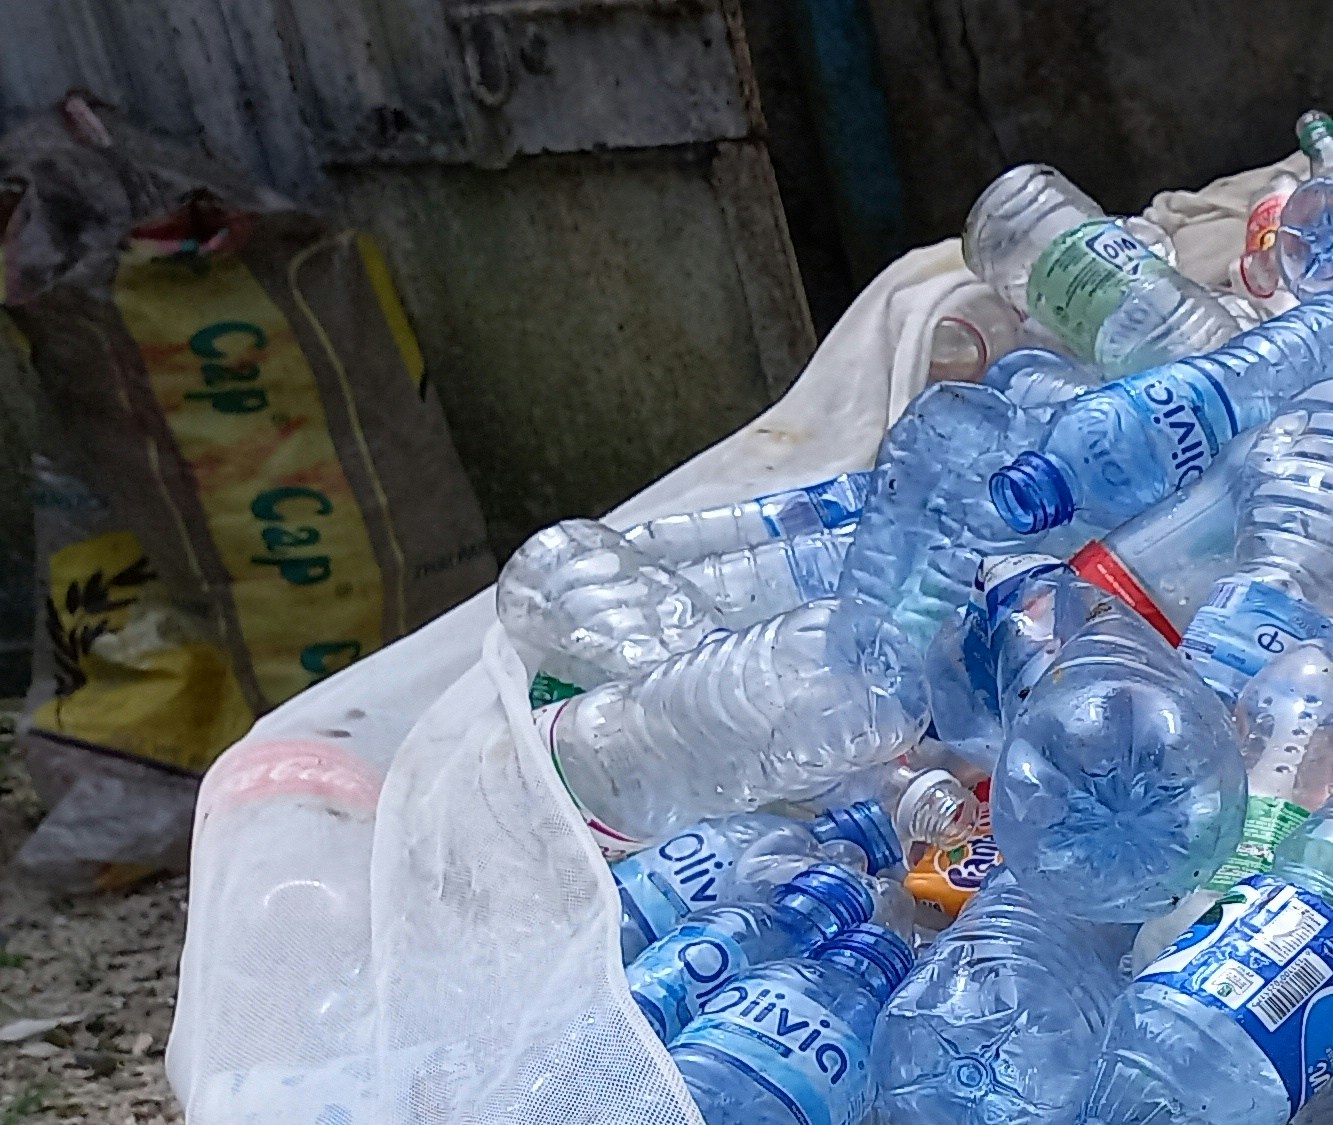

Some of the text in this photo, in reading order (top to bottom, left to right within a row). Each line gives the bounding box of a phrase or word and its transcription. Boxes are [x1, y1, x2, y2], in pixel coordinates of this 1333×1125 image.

[184, 321, 270, 415] Cap
[251, 486, 334, 586] Cap
[659, 833, 725, 902] Oliv
[698, 984, 849, 1087] Olivia
